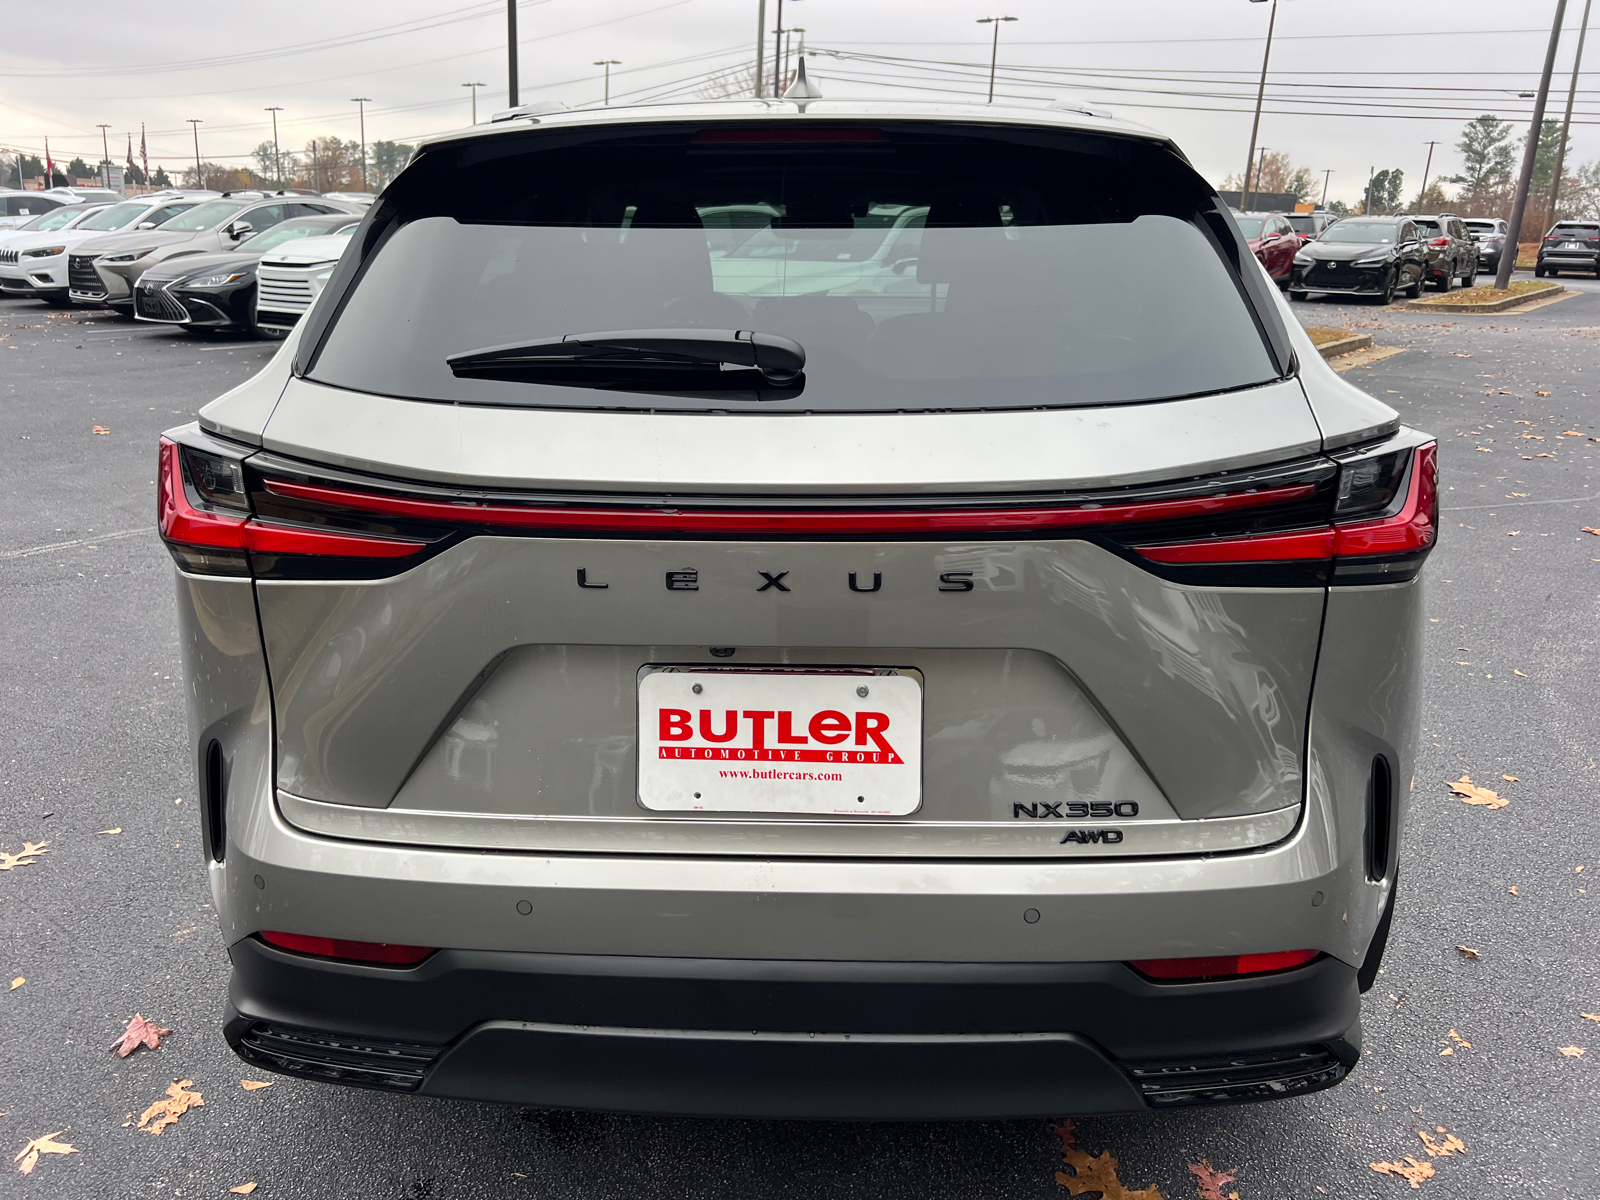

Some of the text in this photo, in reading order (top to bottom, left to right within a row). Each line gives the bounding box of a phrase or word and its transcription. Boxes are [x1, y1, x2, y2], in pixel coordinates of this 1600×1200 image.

[576, 566, 974, 593] LEXUS
[660, 748, 895, 763] AUTOMOTIVE GROUP
[719, 768, 843, 782] www.butlercars.com
[1013, 800, 1139, 819] NX350
[1059, 829, 1124, 844] AWD
